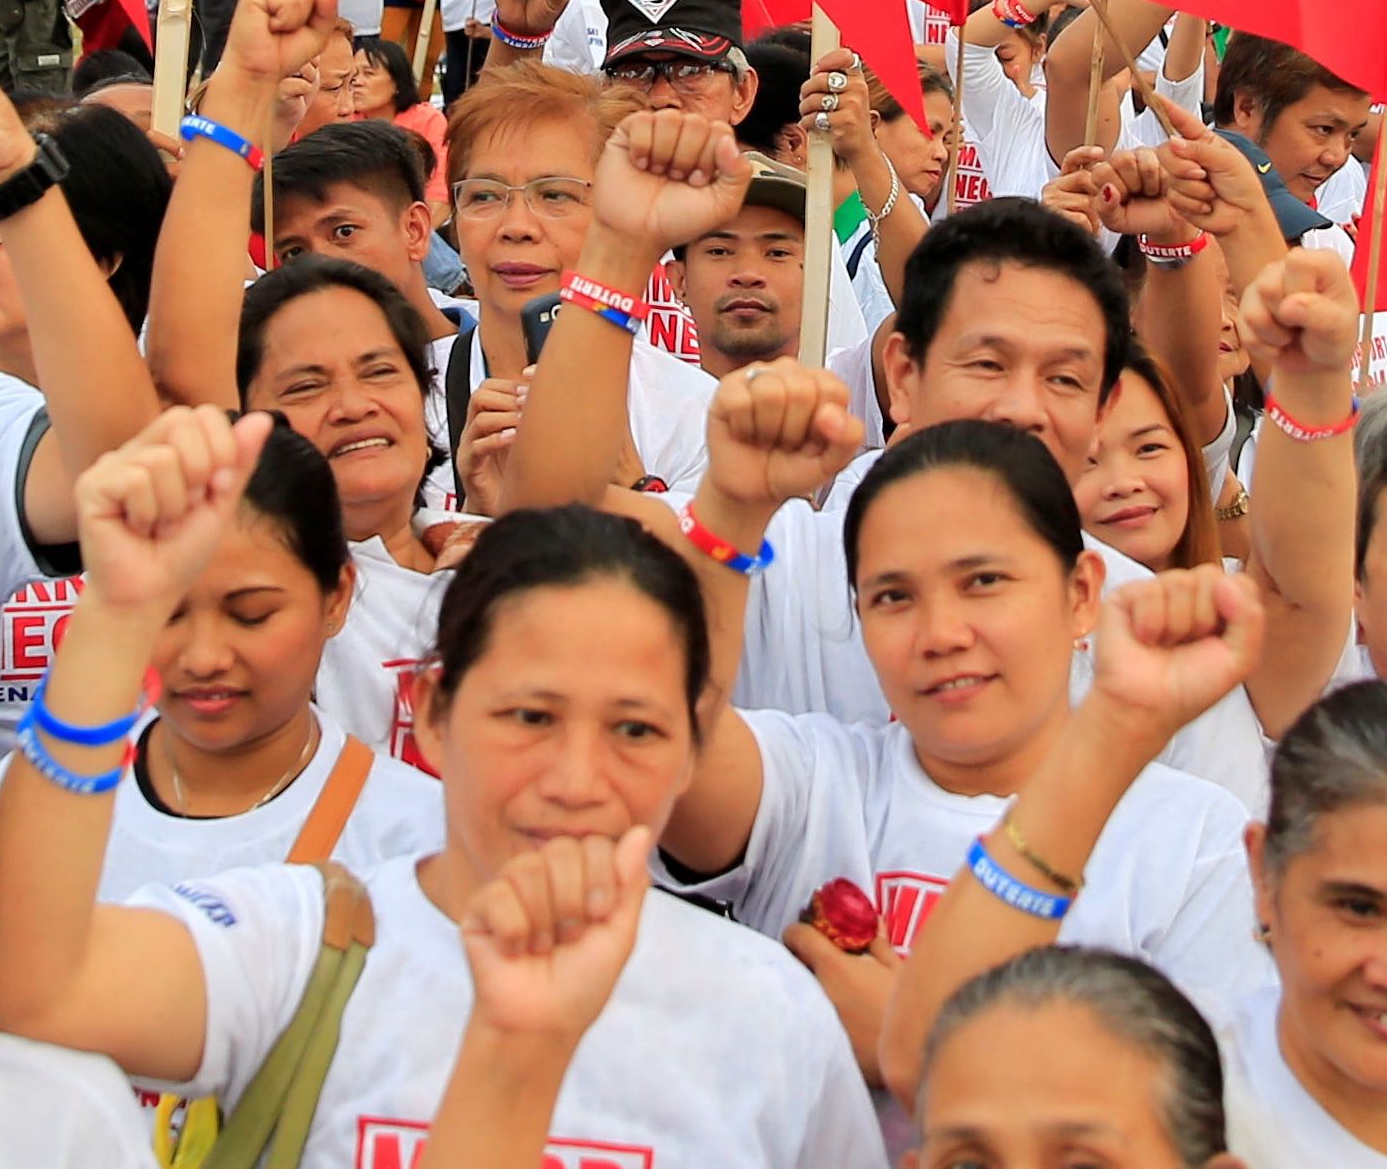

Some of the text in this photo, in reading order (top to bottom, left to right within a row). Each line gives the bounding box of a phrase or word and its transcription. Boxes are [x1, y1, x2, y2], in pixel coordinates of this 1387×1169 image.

[955, 174, 992, 200] NEC
[1140, 243, 1192, 257] DUTERTE
[972, 856, 1056, 917] DUTERTE
